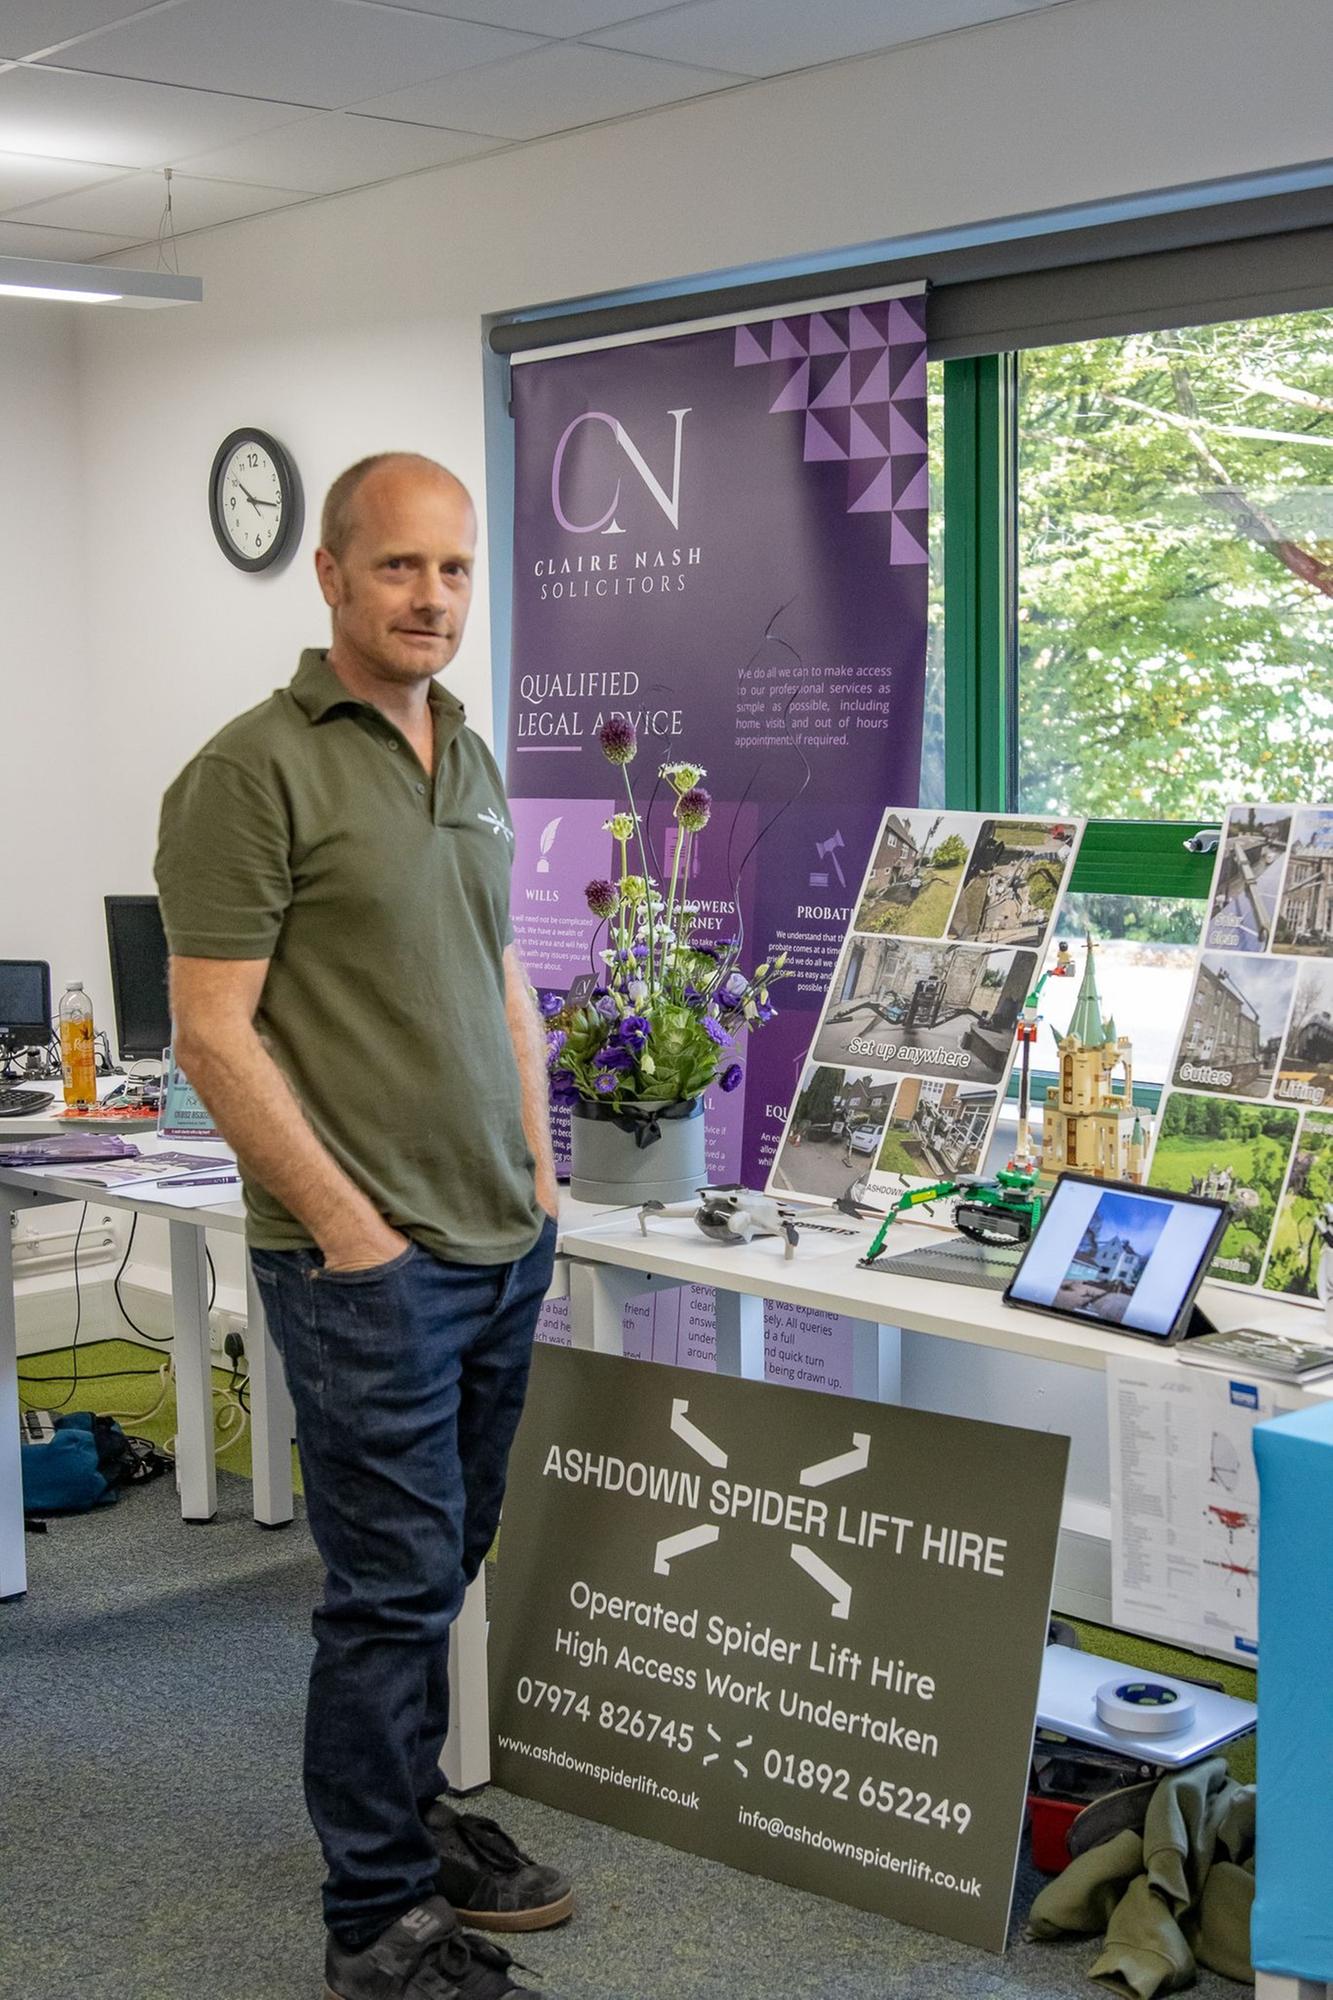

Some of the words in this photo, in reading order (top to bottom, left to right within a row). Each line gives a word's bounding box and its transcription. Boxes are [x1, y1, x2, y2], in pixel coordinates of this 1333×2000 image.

[247, 454, 258, 467] 12
[230, 497, 236, 510] 9
[255, 534, 262, 547] 6
[534, 554, 618, 577] CLAIRE
[635, 547, 701, 568] NASH
[541, 574, 685, 600] SOLICITORS
[738, 668, 752, 679] We
[754, 668, 765, 678] do
[767, 667, 776, 678] all
[778, 669, 791, 677] we
[792, 668, 808, 677] can
[811, 667, 821, 676] to
[824, 665, 853, 676] make
[856, 667, 892, 677] access
[520, 671, 639, 705] QUALIFIED
[751, 685, 766, 696] our
[830, 683, 873, 694] services
[878, 684, 891, 694] as
[772, 702, 782, 712] as
[789, 700, 830, 714] possible,
[840, 700, 890, 714] including
[518, 712, 583, 736] LEGAL
[735, 718, 761, 729] home
[792, 717, 809, 728] and
[815, 718, 832, 728] out
[839, 716, 850, 728] of
[856, 717, 889, 728] hours
[803, 734, 849, 747] required.
[525, 889, 560, 902] WILLS
[776, 931, 786, 939] We
[787, 932, 822, 941] understand
[822, 933, 837, 942] that
[768, 943, 792, 952] probate
[793, 945, 813, 953] comes
[805, 958, 814, 966] do
[814, 958, 822, 966] all
[805, 972, 819, 981] easy
[797, 983, 822, 992] possible
[849, 1037, 876, 1056] Set
[876, 1043, 896, 1060] up
[897, 1046, 971, 1068] anywhere
[1180, 1063, 1232, 1086] Gutters
[761, 1133, 770, 1141] An
[545, 1305, 551, 1313] a
[553, 1303, 568, 1317] bad
[624, 1302, 650, 1317] friend
[776, 1301, 793, 1312] was
[543, 1319, 559, 1330] and
[623, 1319, 635, 1329] ith
[764, 1313, 784, 1328] sely.
[786, 1317, 798, 1329] All
[800, 1322, 833, 1337] queries
[772, 1333, 778, 1341] a
[780, 1330, 795, 1345] full
[764, 1346, 776, 1358] nd
[778, 1349, 803, 1364] quick
[805, 1354, 825, 1368] turn
[769, 1362, 795, 1381] being
[797, 1366, 825, 1384] drawn
[828, 1376, 842, 1389] up.
[543, 1445, 700, 1509] ASHDOWN
[709, 1480, 828, 1537] SPIDER
[837, 1507, 913, 1554] LIFT
[922, 1527, 1008, 1577] HIRE
[569, 1581, 698, 1640] Operated
[706, 1616, 802, 1665] Spider
[810, 1641, 862, 1681] Lift
[871, 1657, 936, 1701] Hire
[556, 1629, 608, 1671] High
[615, 1649, 697, 1690] Access
[704, 1669, 770, 1712] Work
[779, 1690, 938, 1757] Undertaken
[516, 1676, 592, 1724] 07974
[598, 1701, 695, 1753] 826745
[764, 1749, 849, 1801] 01892
[858, 1777, 972, 1835] 652249
[498, 1734, 700, 1811] www.ashdownspiderlift.co.uk
[738, 1806, 982, 1898] info@ashdownspiderlift.co.uk
